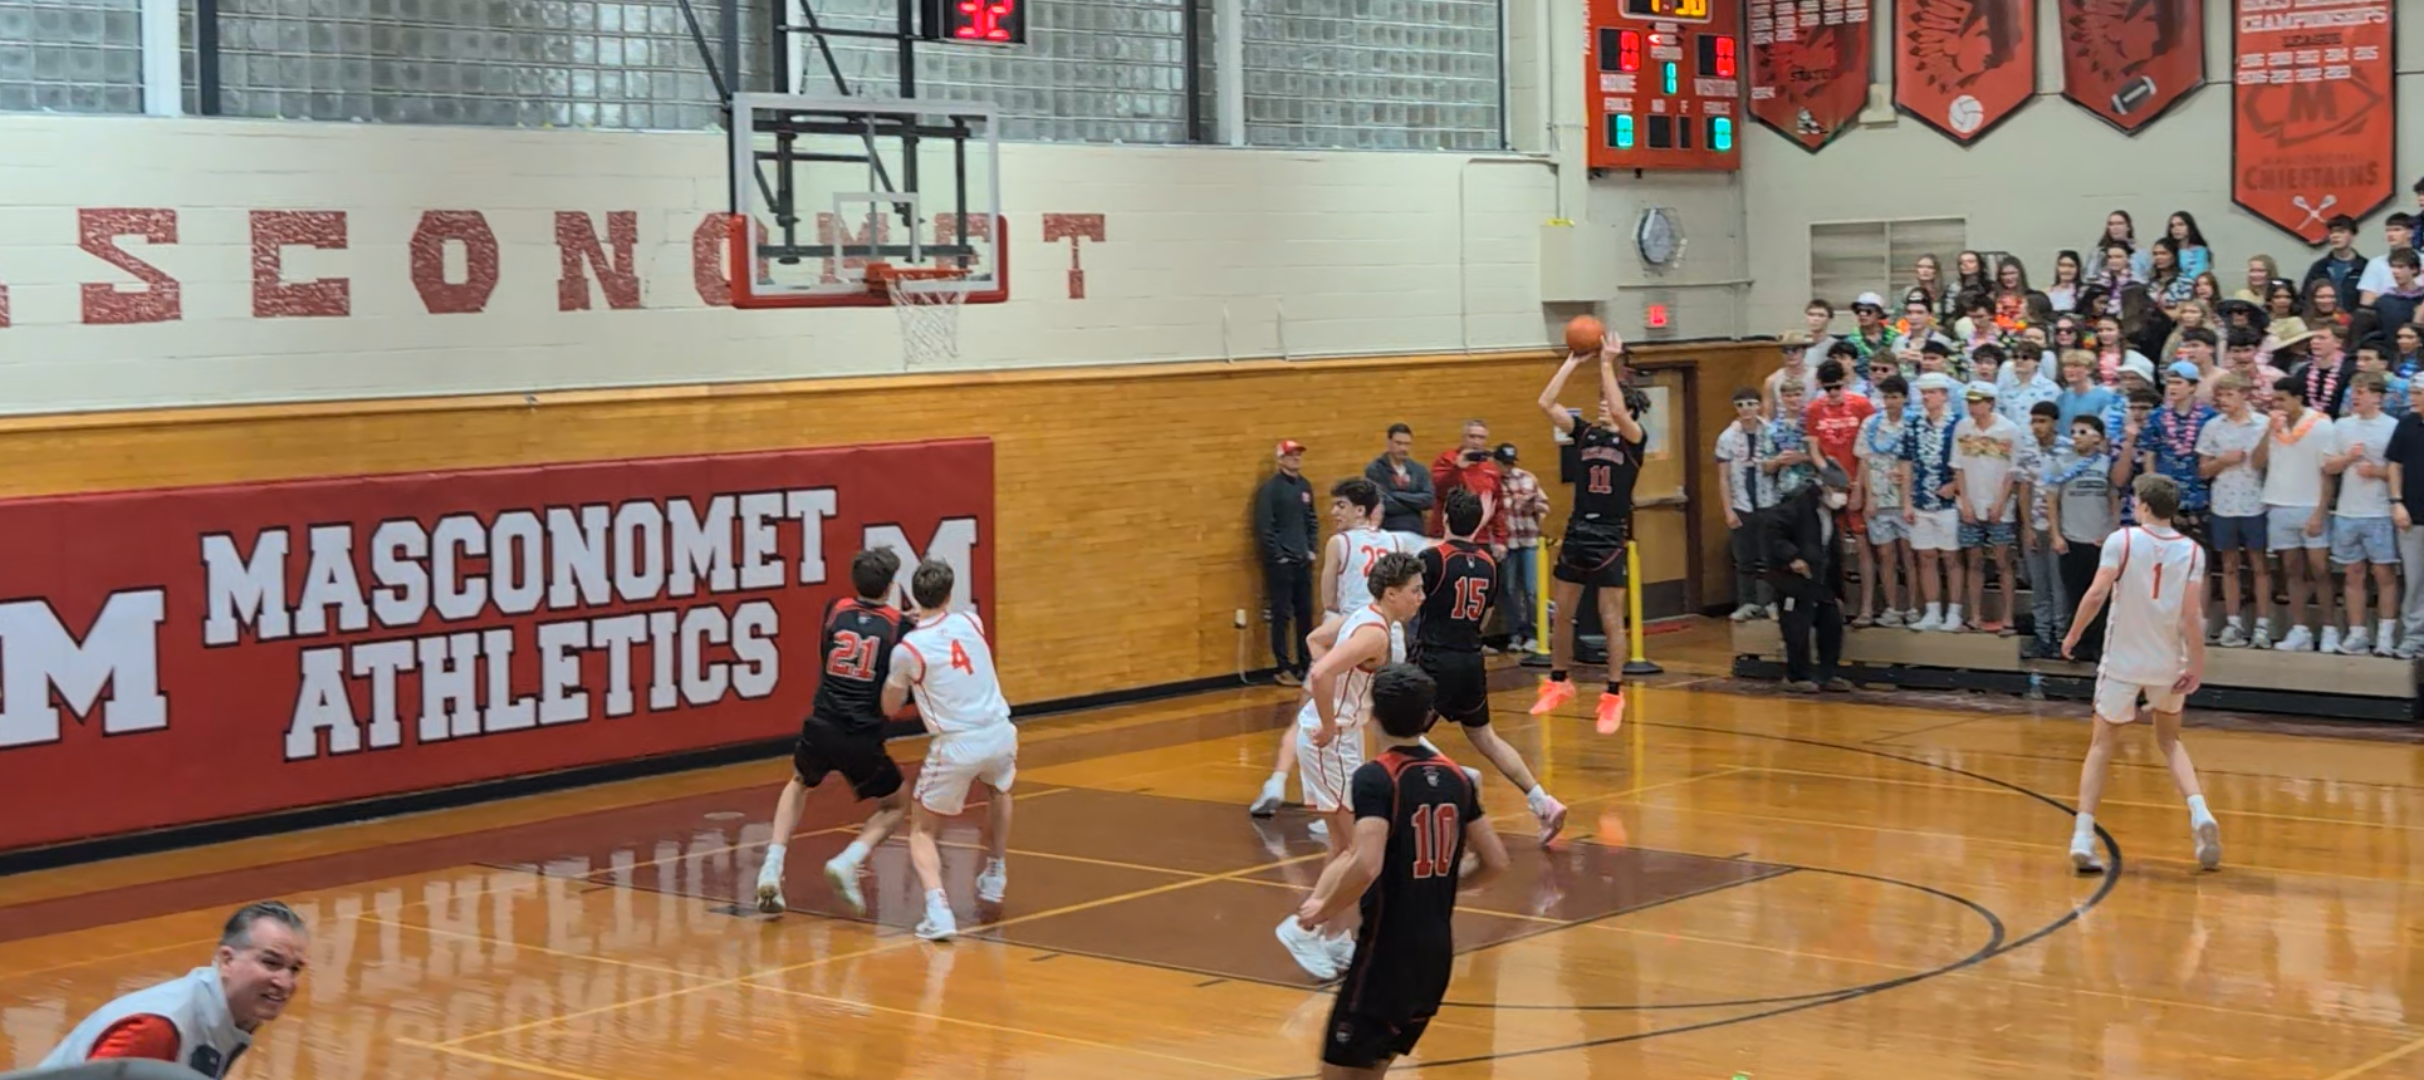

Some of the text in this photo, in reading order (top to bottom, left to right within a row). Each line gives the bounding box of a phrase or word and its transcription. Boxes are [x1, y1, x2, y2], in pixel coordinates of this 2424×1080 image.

[955, 0, 1013, 40] 32
[2243, 161, 2379, 190] CHIEFTAINS
[1588, 465, 1612, 494] 11
[202, 488, 838, 646] MASCONOMET
[2153, 563, 2162, 600] 1
[1451, 576, 1489, 621] 15
[0, 588, 168, 747] M
[826, 630, 880, 682] 21
[951, 639, 974, 676] 4
[285, 600, 780, 760] ATHLETICS
[1411, 803, 1460, 879] 10
